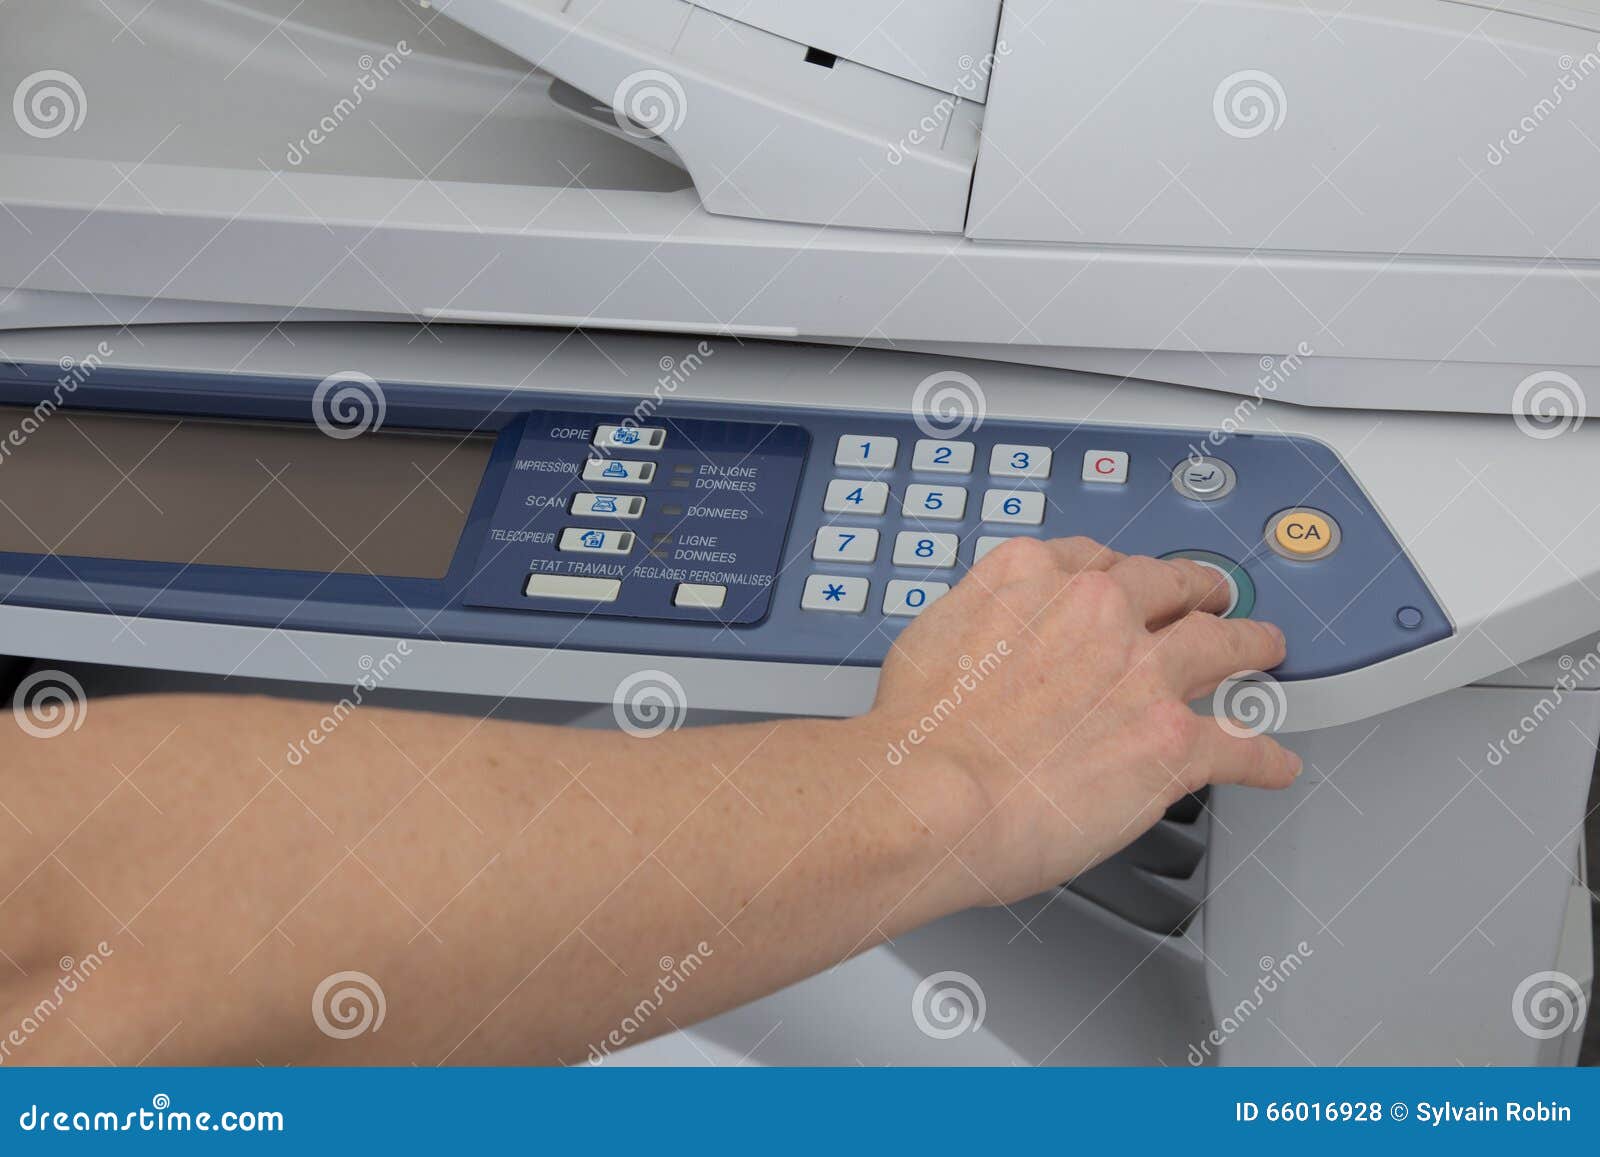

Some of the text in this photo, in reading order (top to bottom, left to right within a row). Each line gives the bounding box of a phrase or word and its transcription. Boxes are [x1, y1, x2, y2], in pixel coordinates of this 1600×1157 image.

[550, 428, 591, 440] COPIE
[860, 442, 1029, 469] 1 2 3
[514, 460, 580, 473] IMPRESSION
[700, 465, 757, 478] EN LIGNE
[1095, 457, 1115, 474] C
[695, 478, 757, 492] DONNEES
[525, 495, 567, 508] SCAN
[845, 487, 1022, 515] 4 5 6
[687, 506, 748, 520] DONNEES
[490, 529, 556, 544] TELECOPIEUR
[1286, 523, 1321, 540] CA
[678, 535, 718, 547] LIGNE
[838, 534, 934, 558] 7 8
[674, 549, 737, 563] DONNEES
[529, 559, 626, 576] ETAT TRAVAUX
[633, 566, 772, 587] REGLAGES PERSONNALISES
